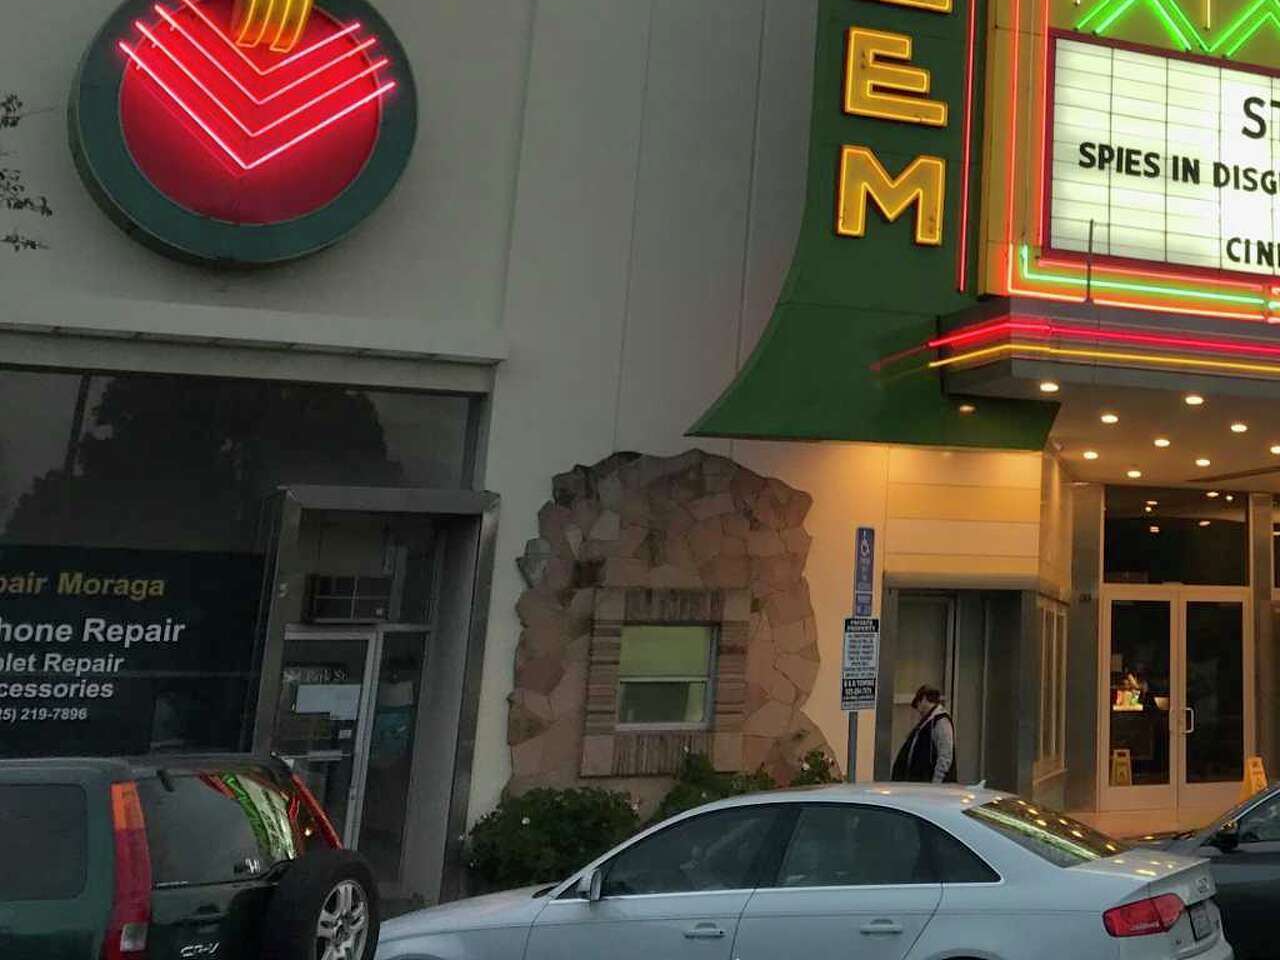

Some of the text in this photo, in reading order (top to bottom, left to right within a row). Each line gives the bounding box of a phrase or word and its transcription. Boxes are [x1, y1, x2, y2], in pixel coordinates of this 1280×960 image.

[1078, 141, 1161, 178] SPIES
[1172, 155, 1201, 185] IN
[57, 572, 165, 601] Moraga
[0, 617, 186, 649] hone Repair
[43, 653, 125, 677] Repair
[0, 679, 114, 699] cessories
[0, 707, 17, 722] 5)
